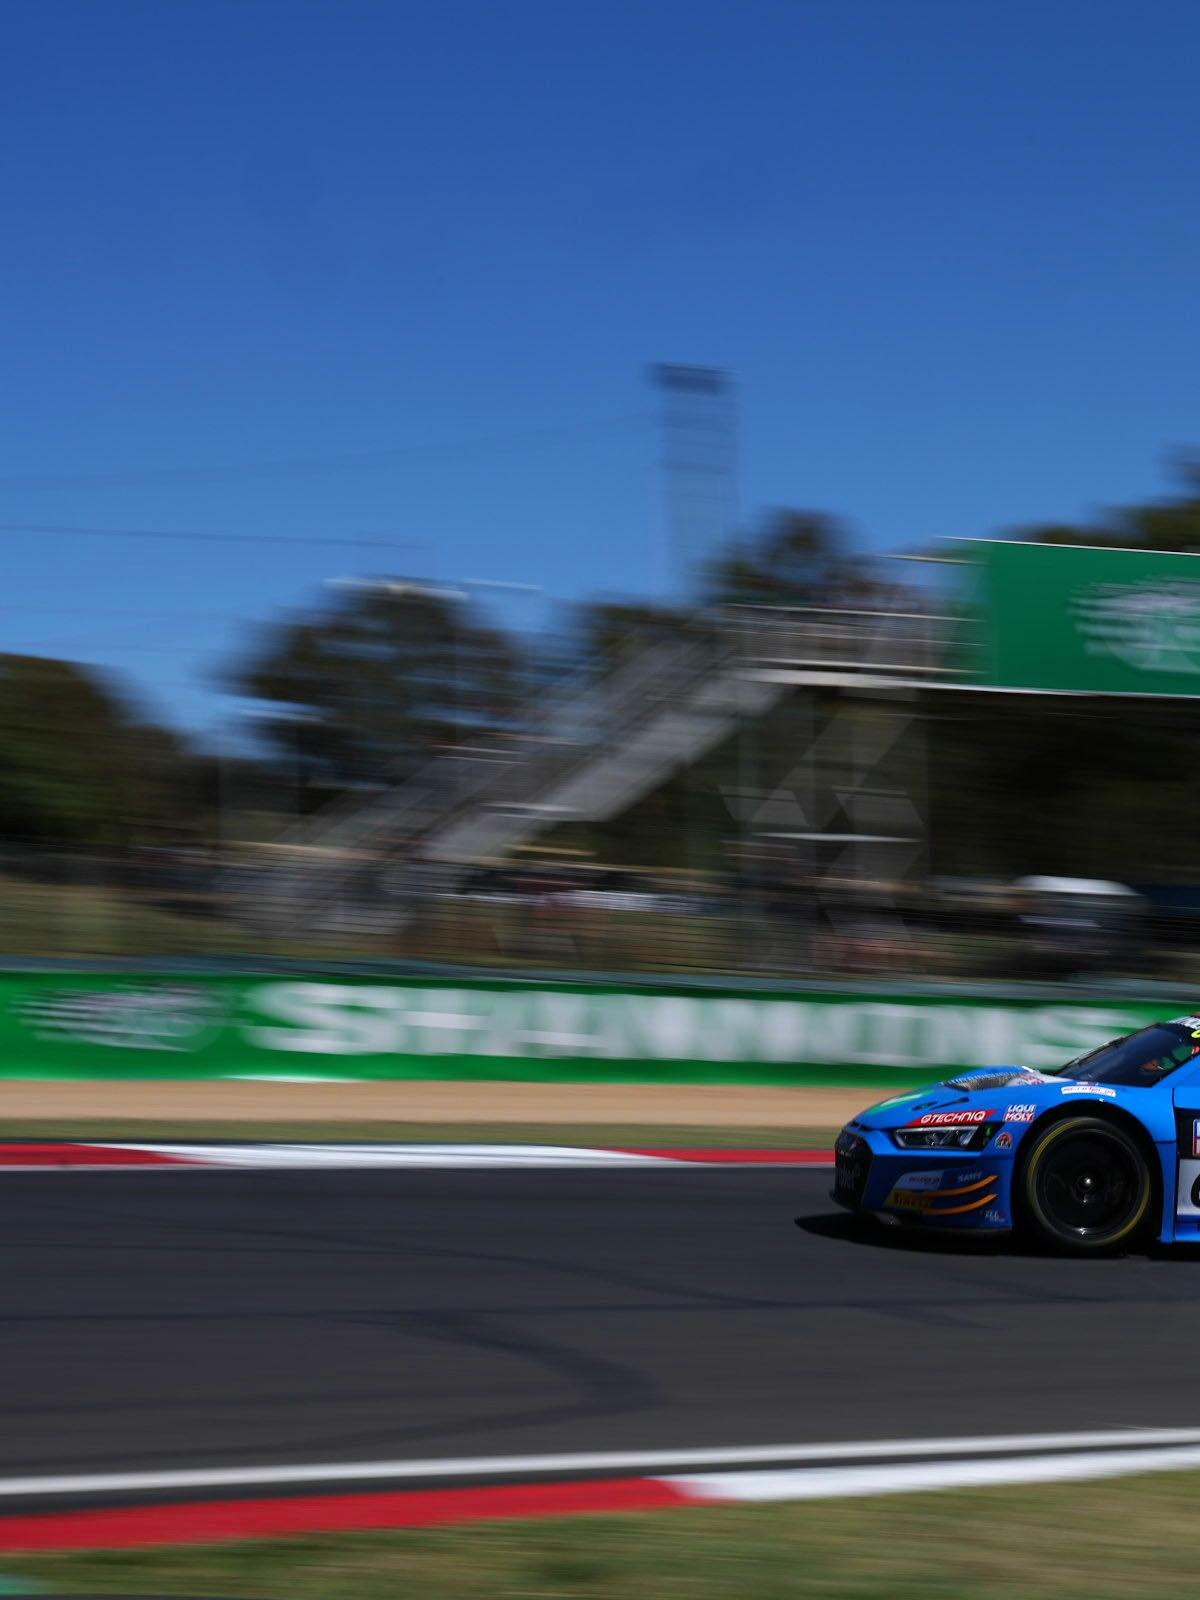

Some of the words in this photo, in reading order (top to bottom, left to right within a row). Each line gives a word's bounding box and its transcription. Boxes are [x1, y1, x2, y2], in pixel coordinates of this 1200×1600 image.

[1007, 1104, 1036, 1113] LIQUI
[920, 1110, 987, 1124] GTECHNIQ
[1004, 1112, 1035, 1122] MOLY
